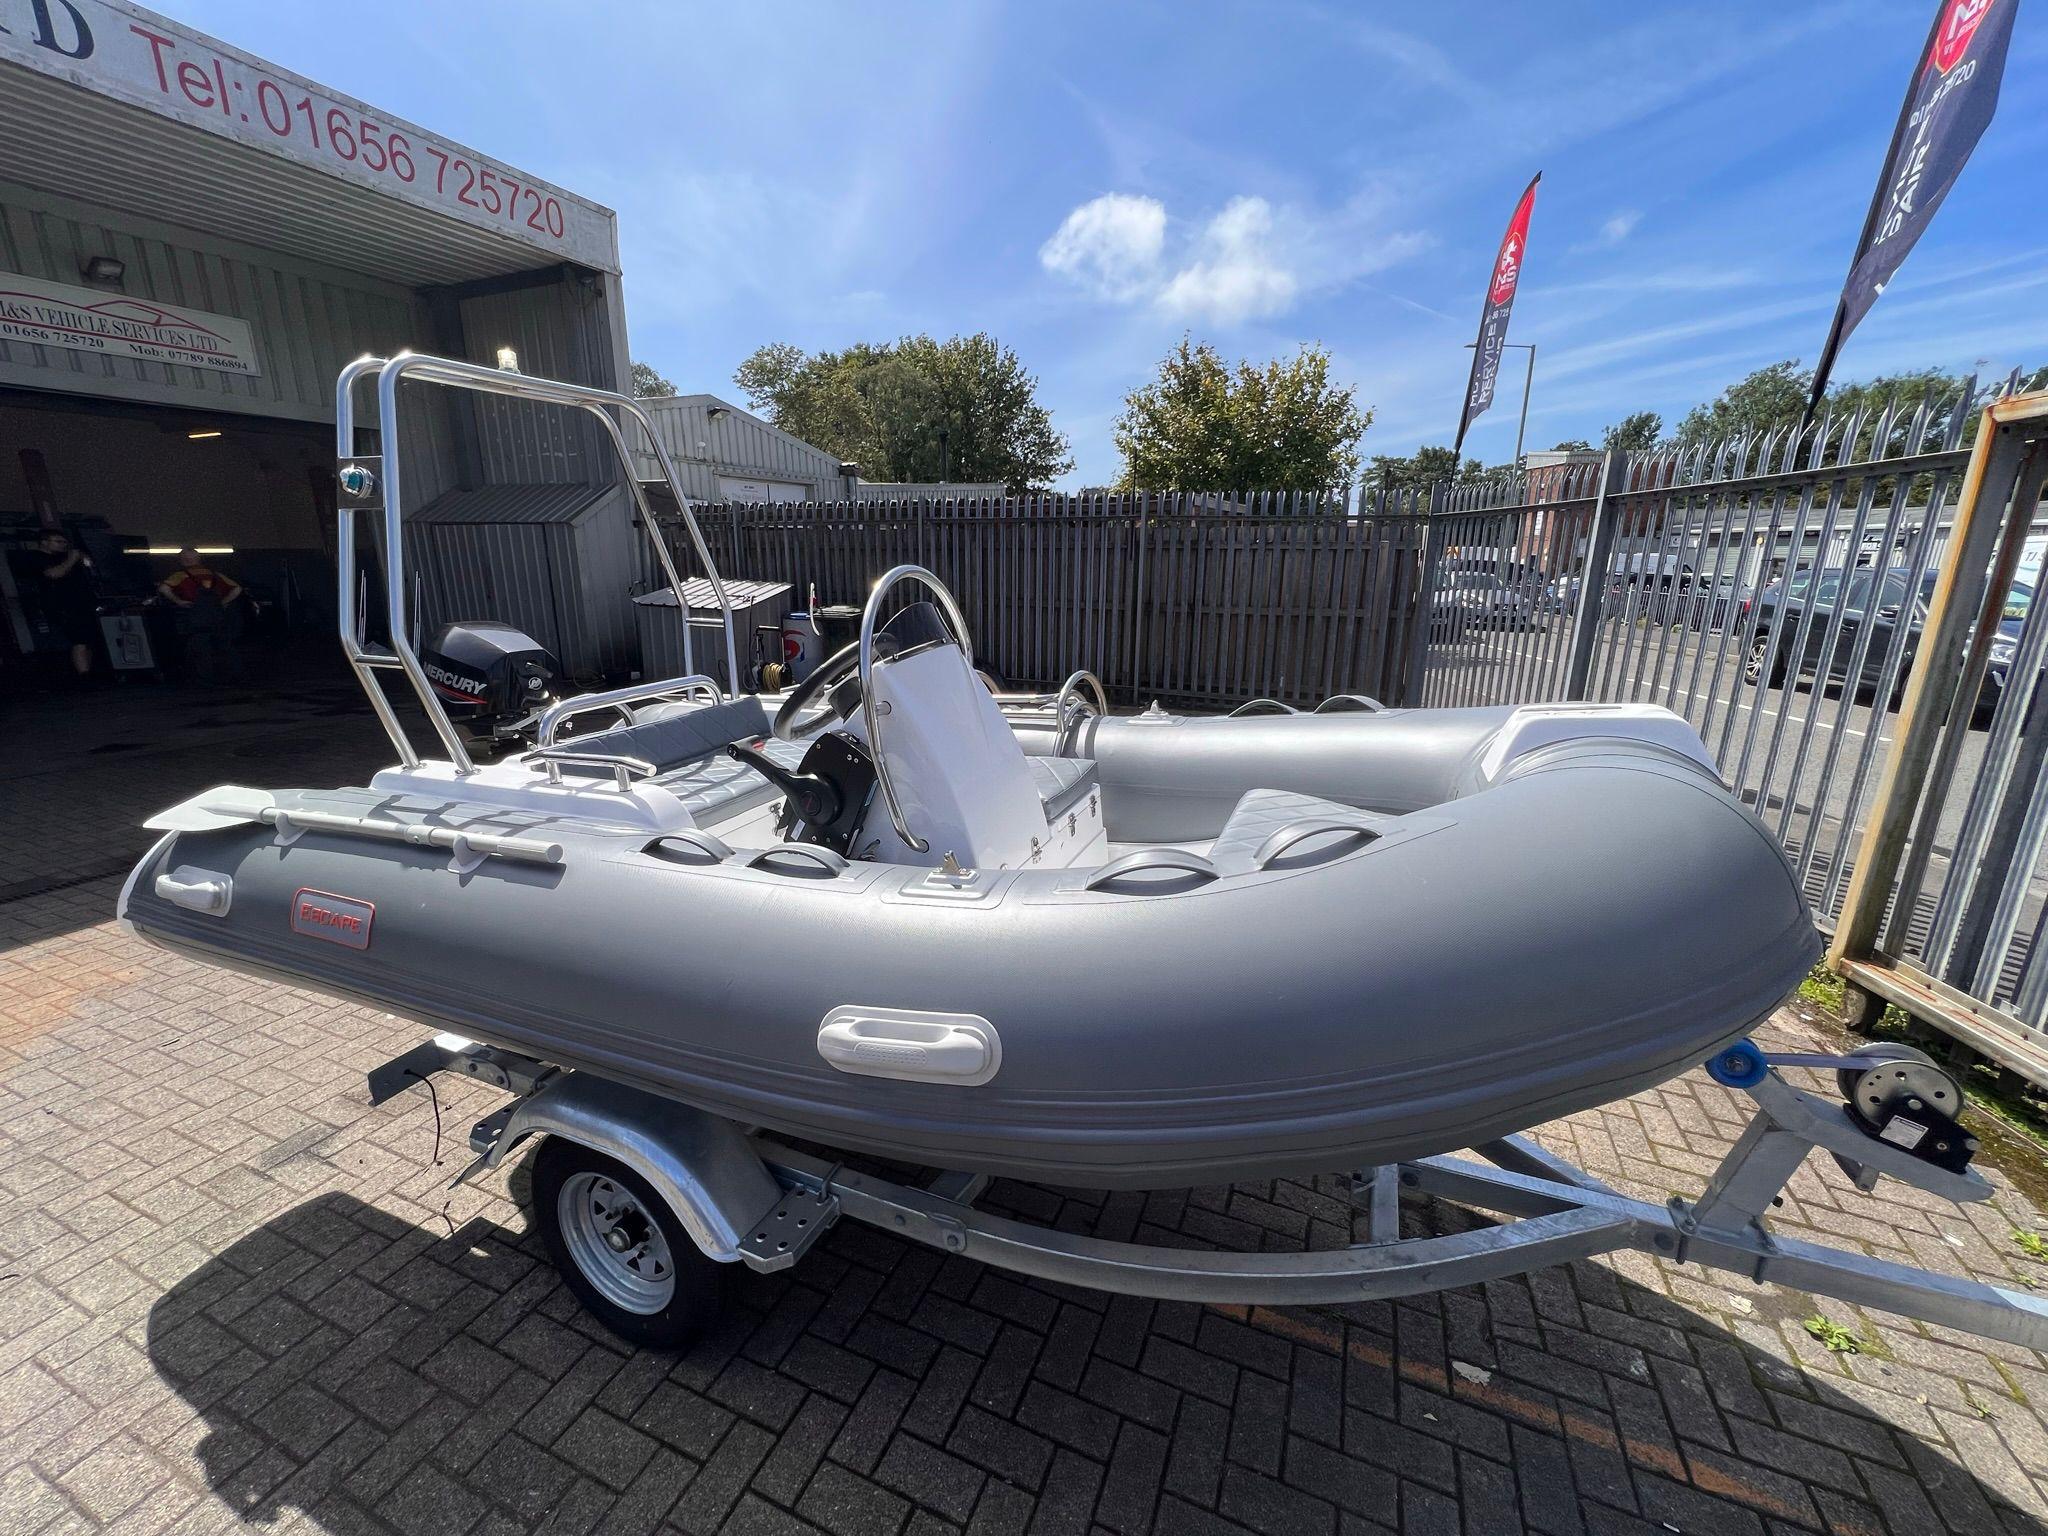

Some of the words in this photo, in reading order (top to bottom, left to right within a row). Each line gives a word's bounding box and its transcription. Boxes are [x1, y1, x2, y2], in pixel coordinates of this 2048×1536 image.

[426, 146, 564, 239] 725720
[2, 323, 49, 340] 01656
[53, 331, 104, 349] 725720
[34, 306, 110, 334] VEHICLE
[112, 321, 187, 347] SERVICES
[189, 333, 218, 351] LTD
[129, 343, 165, 358] Mob:
[168, 349, 204, 363] 07789
[207, 356, 248, 371] 886894
[422, 661, 488, 695] MERCURY
[301, 902, 362, 934] ESCAPE
